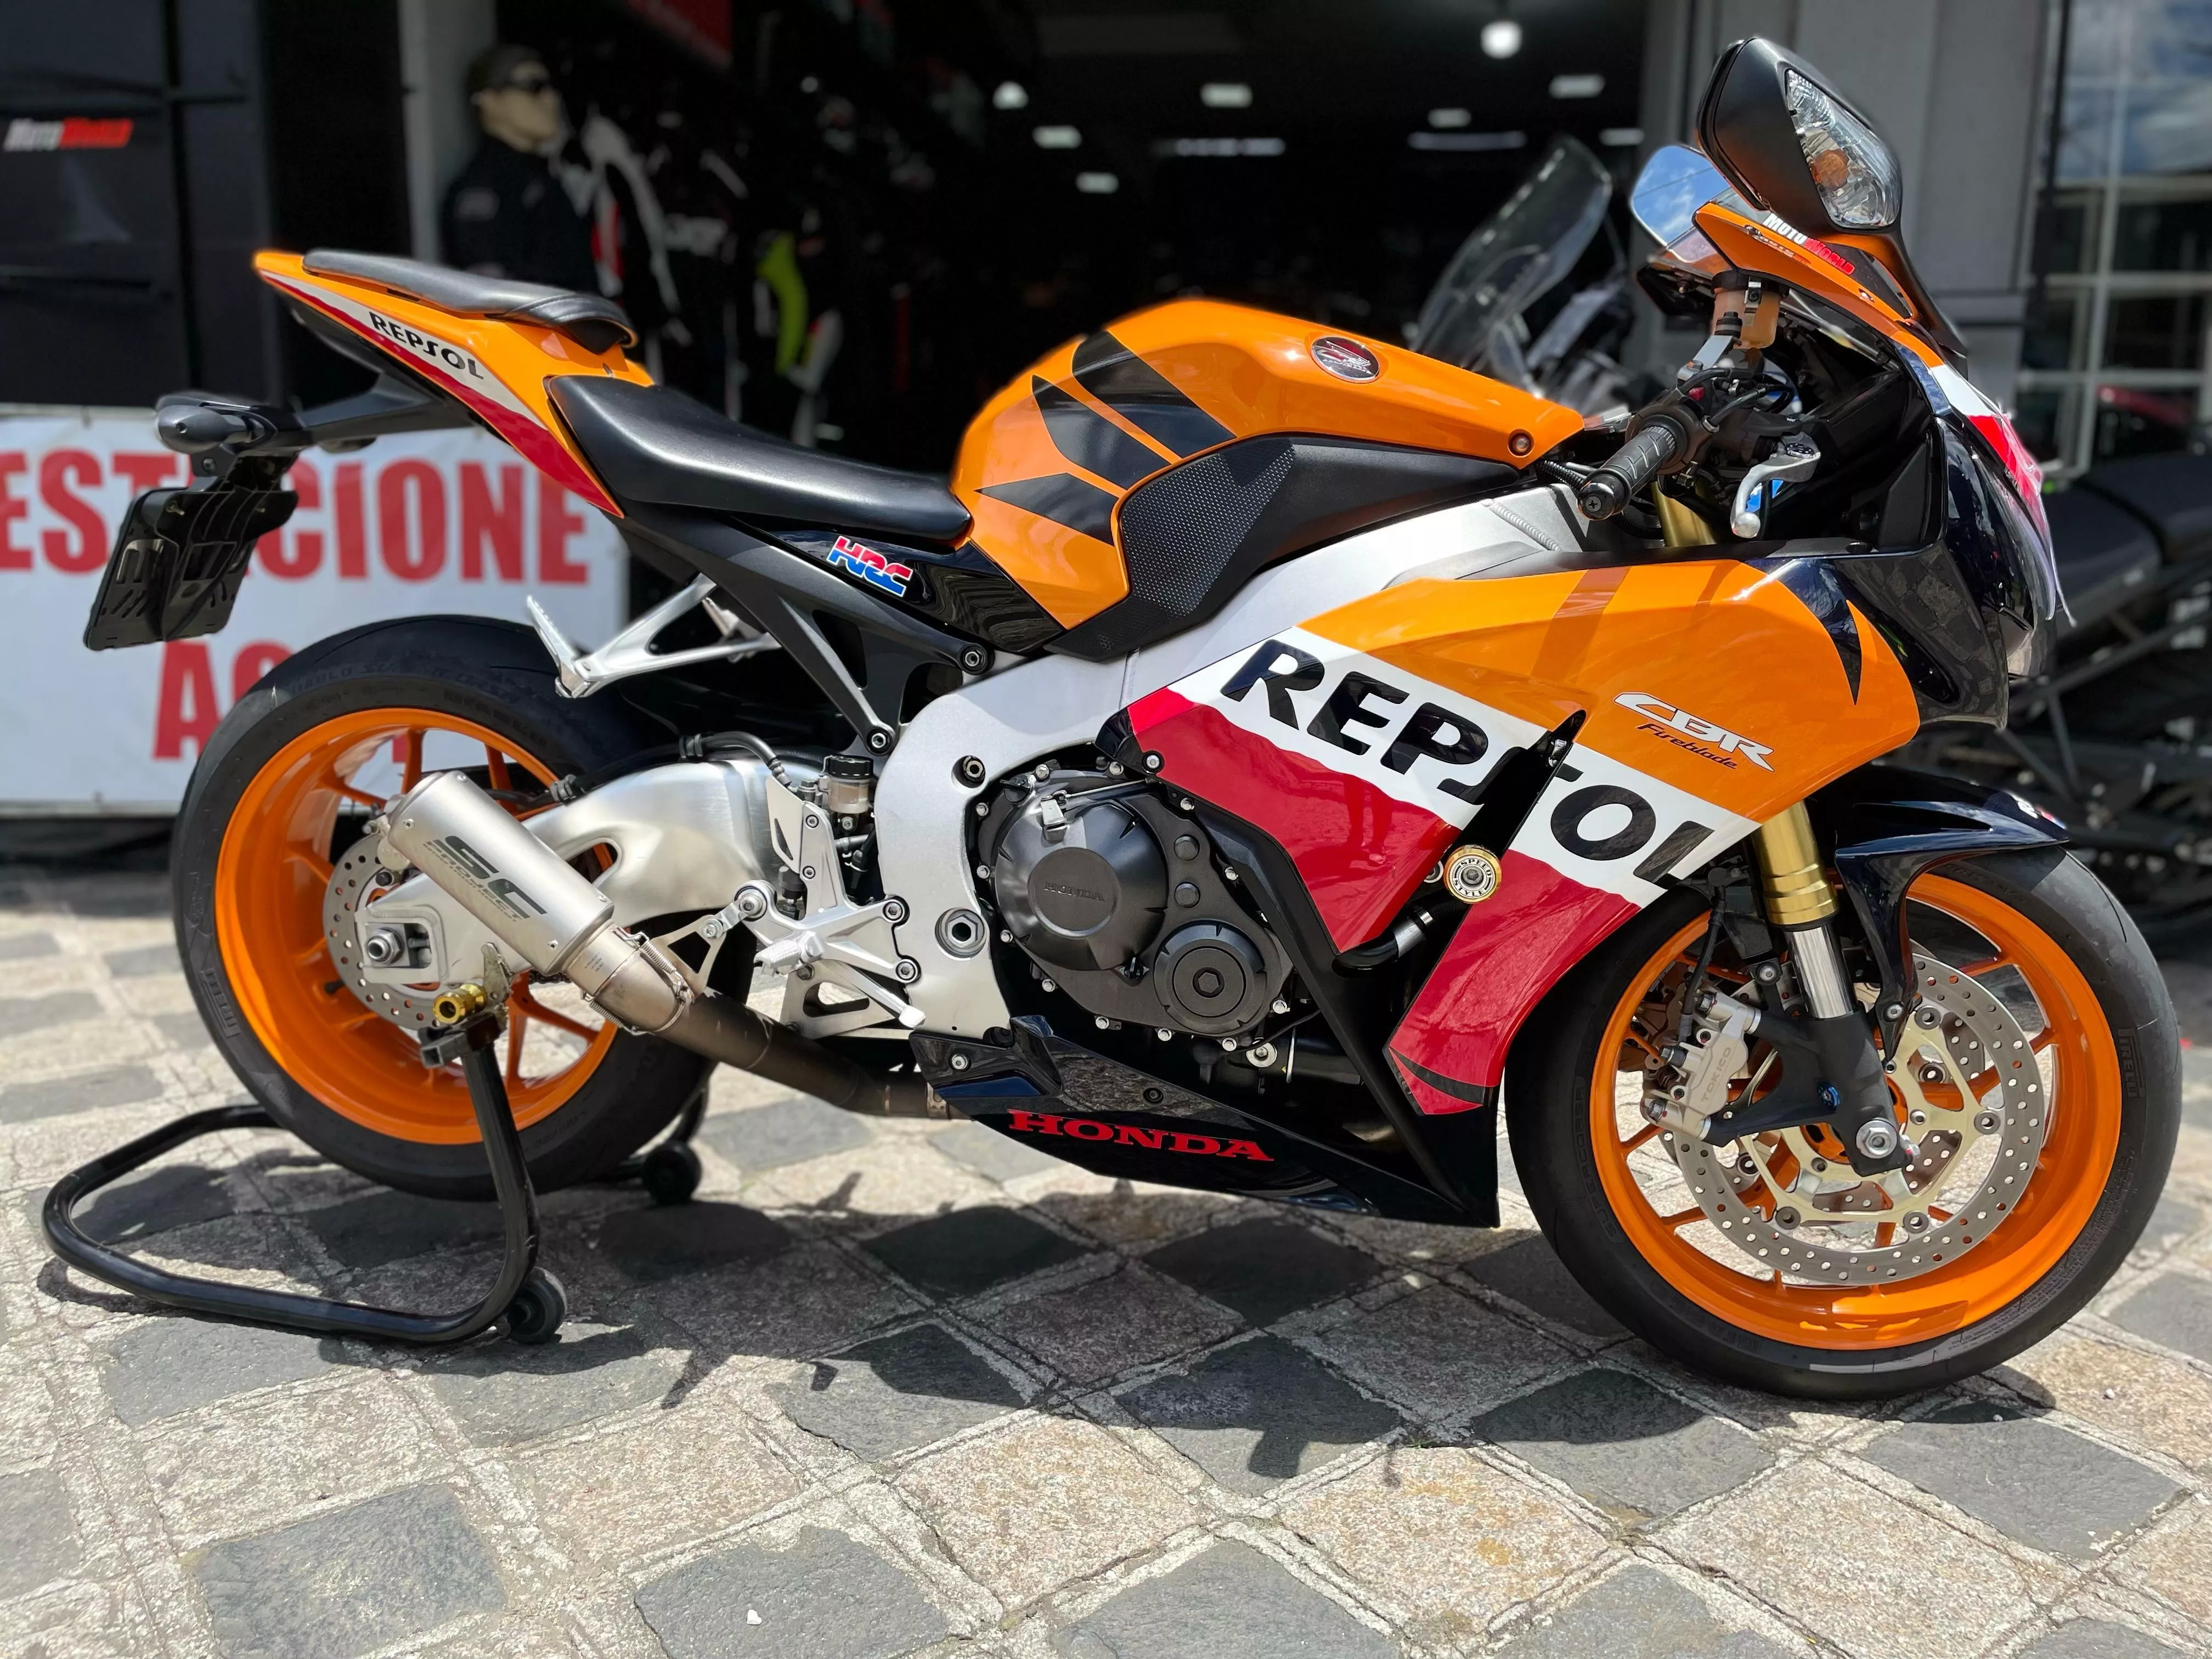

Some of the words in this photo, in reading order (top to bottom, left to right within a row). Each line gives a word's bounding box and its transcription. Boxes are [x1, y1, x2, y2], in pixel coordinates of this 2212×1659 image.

[369, 311, 484, 380] REPSOL
[0, 445, 588, 584] ESCIONE
[826, 535, 913, 597] HRC
[1613, 692, 1775, 772] CBR
[1635, 723, 1739, 769] Fireblade
[425, 841, 523, 920] PROJECT
[432, 836, 548, 919] SC
[1043, 882, 1106, 902] HONDA
[1454, 879, 1486, 896] STYLE
[1460, 858, 1492, 877] SPEED
[1701, 1047, 1732, 1102] TOKICO
[2118, 1027, 2147, 1099] PIRELLI
[1007, 1109, 1274, 1161] HONDA
